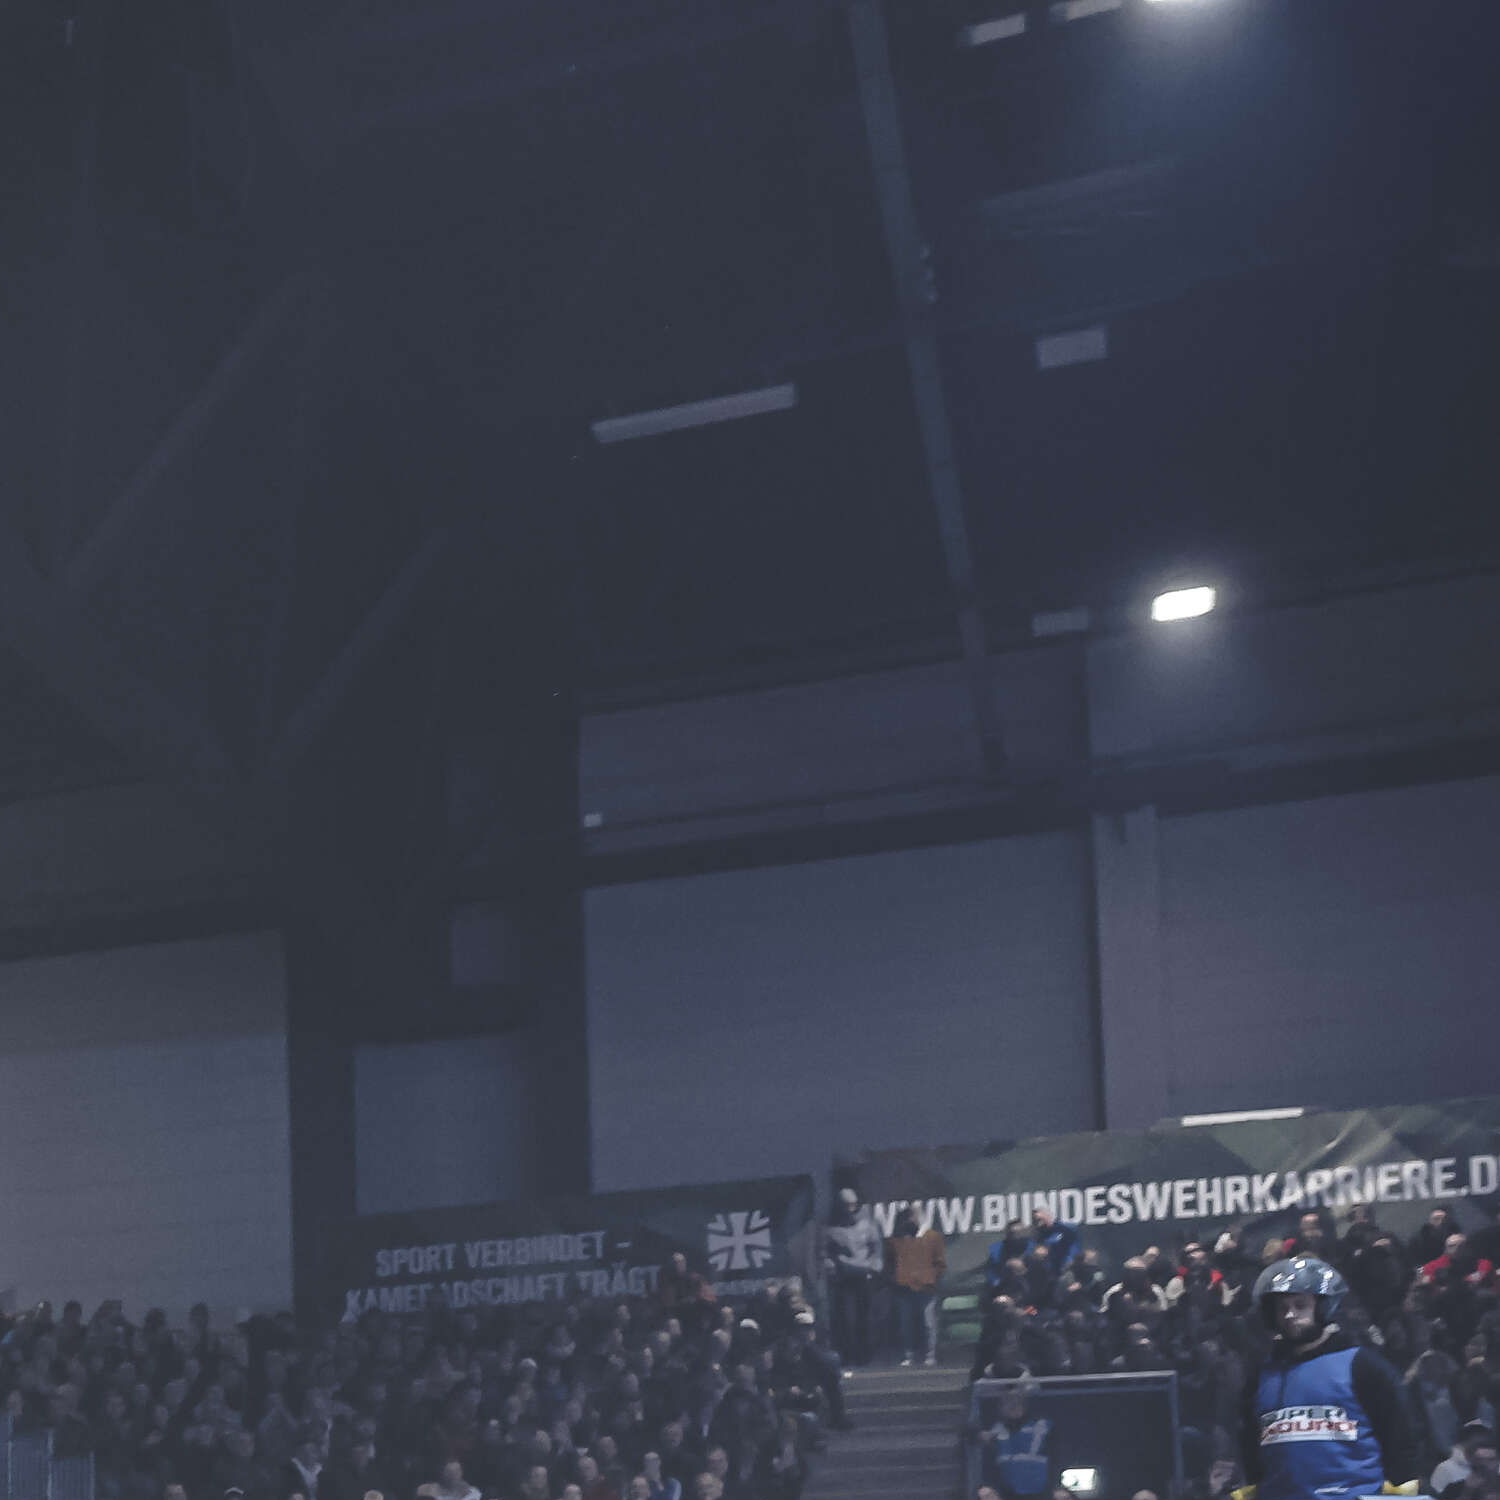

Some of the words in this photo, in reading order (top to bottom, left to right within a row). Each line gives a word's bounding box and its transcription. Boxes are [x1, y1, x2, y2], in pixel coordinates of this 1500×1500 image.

[864, 1154, 1500, 1238] WWW.BUNDESWEHRKARRIERE.D
[376, 1243, 455, 1278] SPORT
[464, 1231, 607, 1269] VERBINDET
[579, 1262, 662, 1300] TRÄGT
